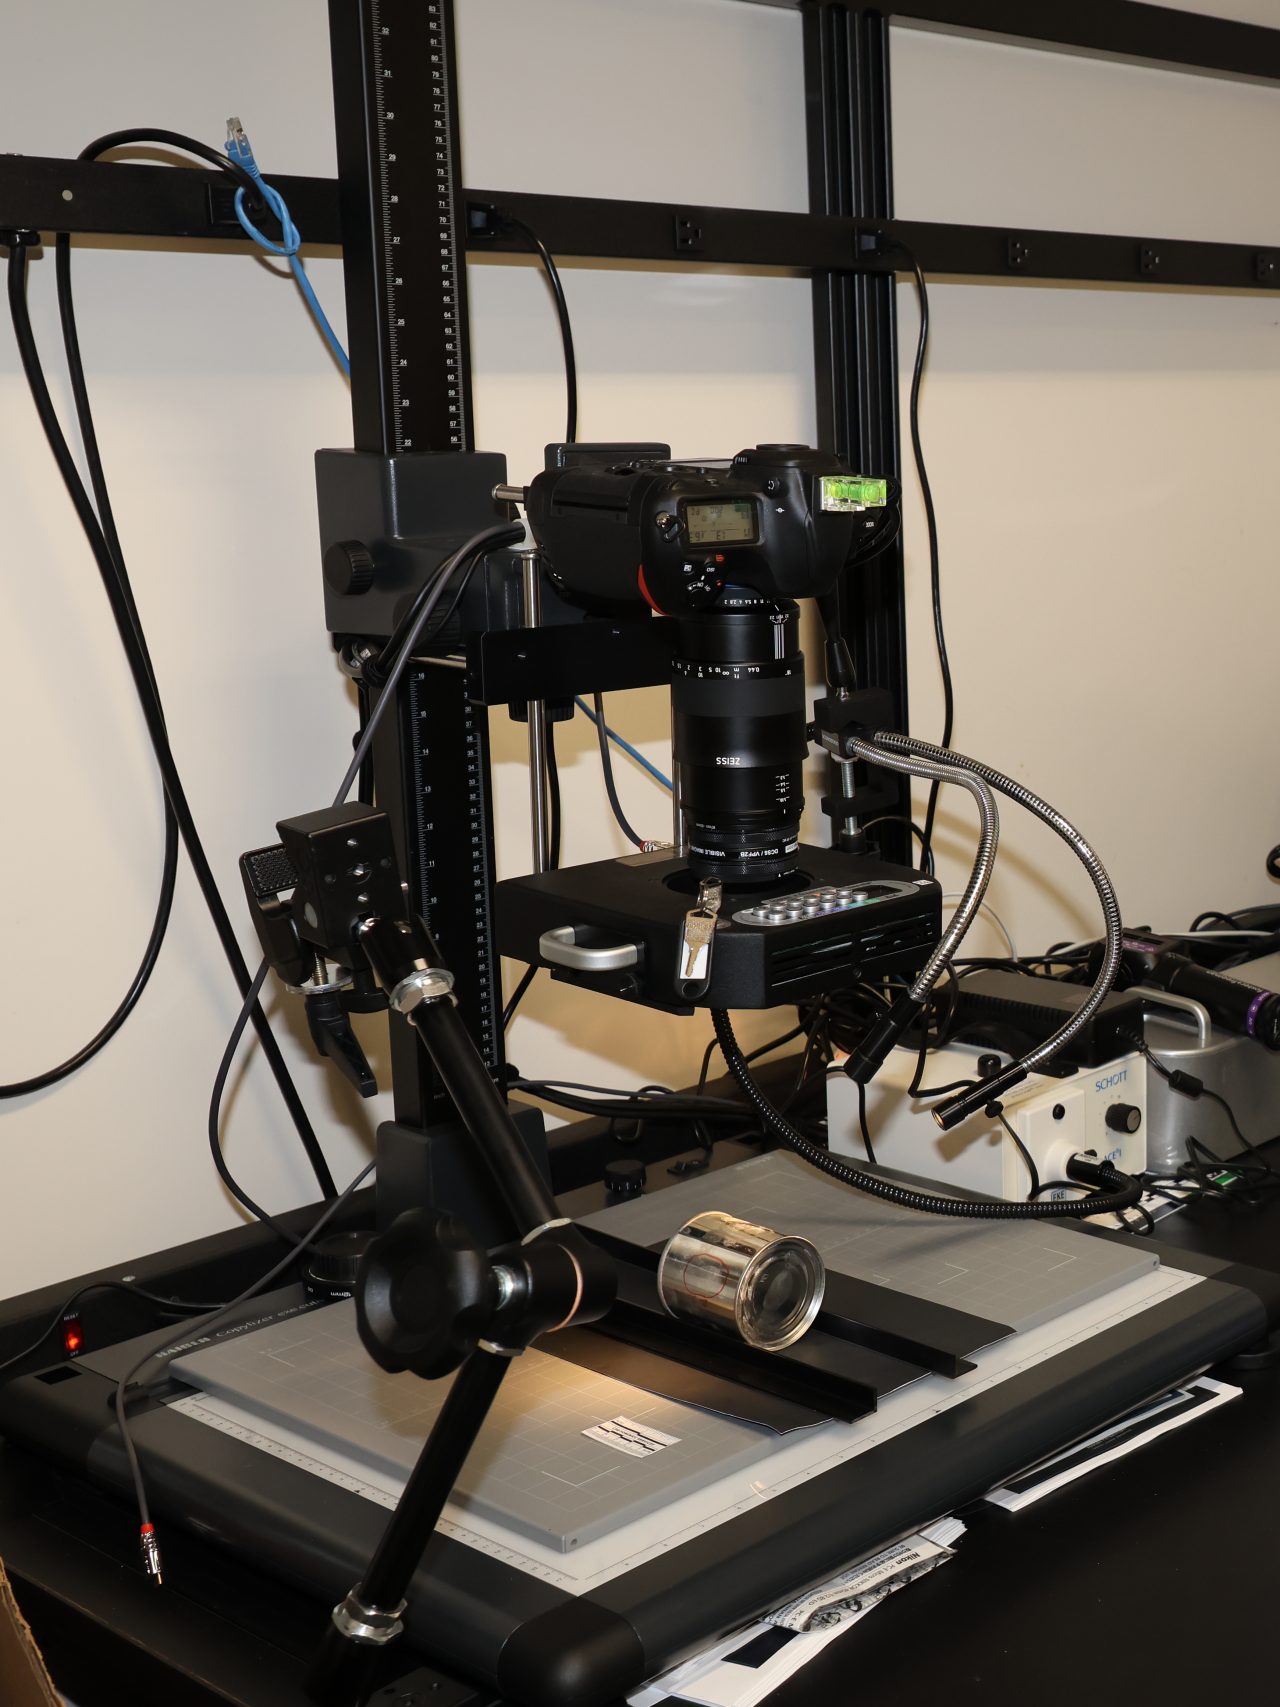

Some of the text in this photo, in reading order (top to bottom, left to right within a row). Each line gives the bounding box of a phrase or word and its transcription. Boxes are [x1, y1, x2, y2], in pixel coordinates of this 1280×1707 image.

[716, 757, 741, 765] ZEISS
[1095, 1069, 1128, 1093] SCHOTT
[895, 1551, 921, 1565] Nikon
